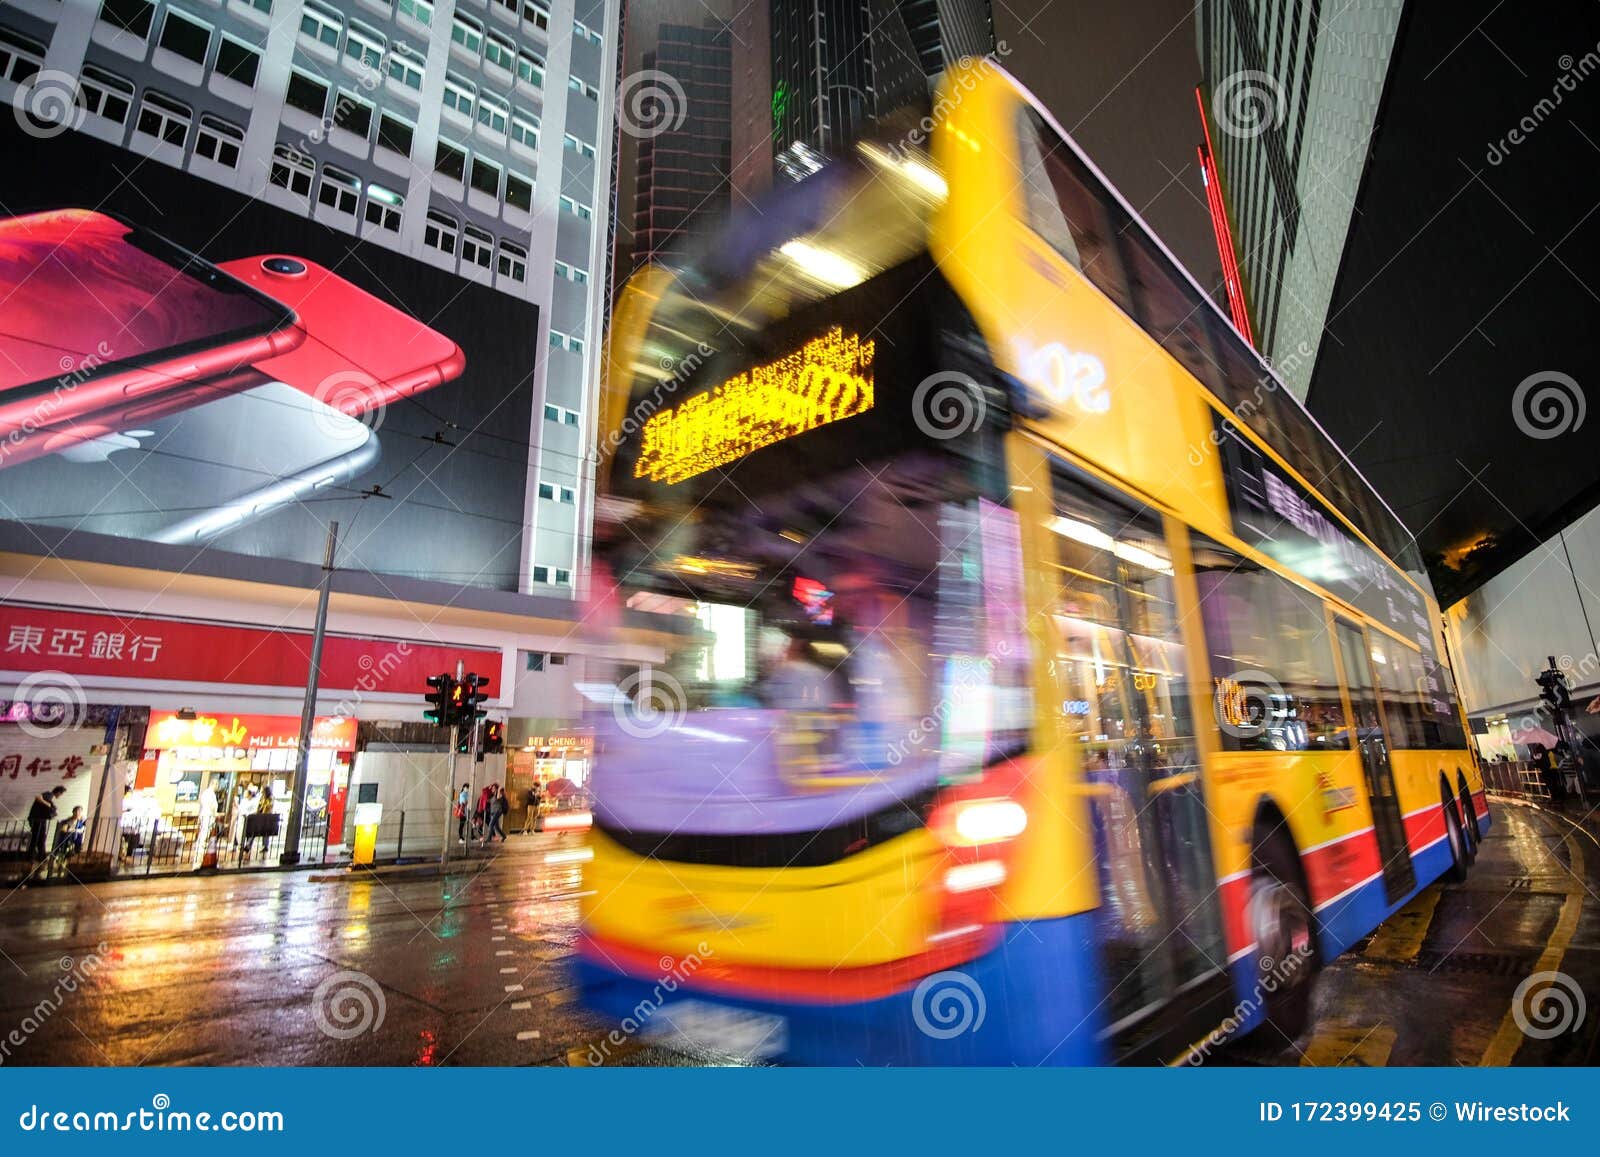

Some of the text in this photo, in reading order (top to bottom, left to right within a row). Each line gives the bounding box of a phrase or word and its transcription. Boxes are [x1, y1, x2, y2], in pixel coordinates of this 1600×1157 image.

[5, 625, 162, 663] 東亞銀行
[250, 736, 273, 746] HUI
[277, 736, 300, 747] LA
[548, 736, 576, 747] CHENG
